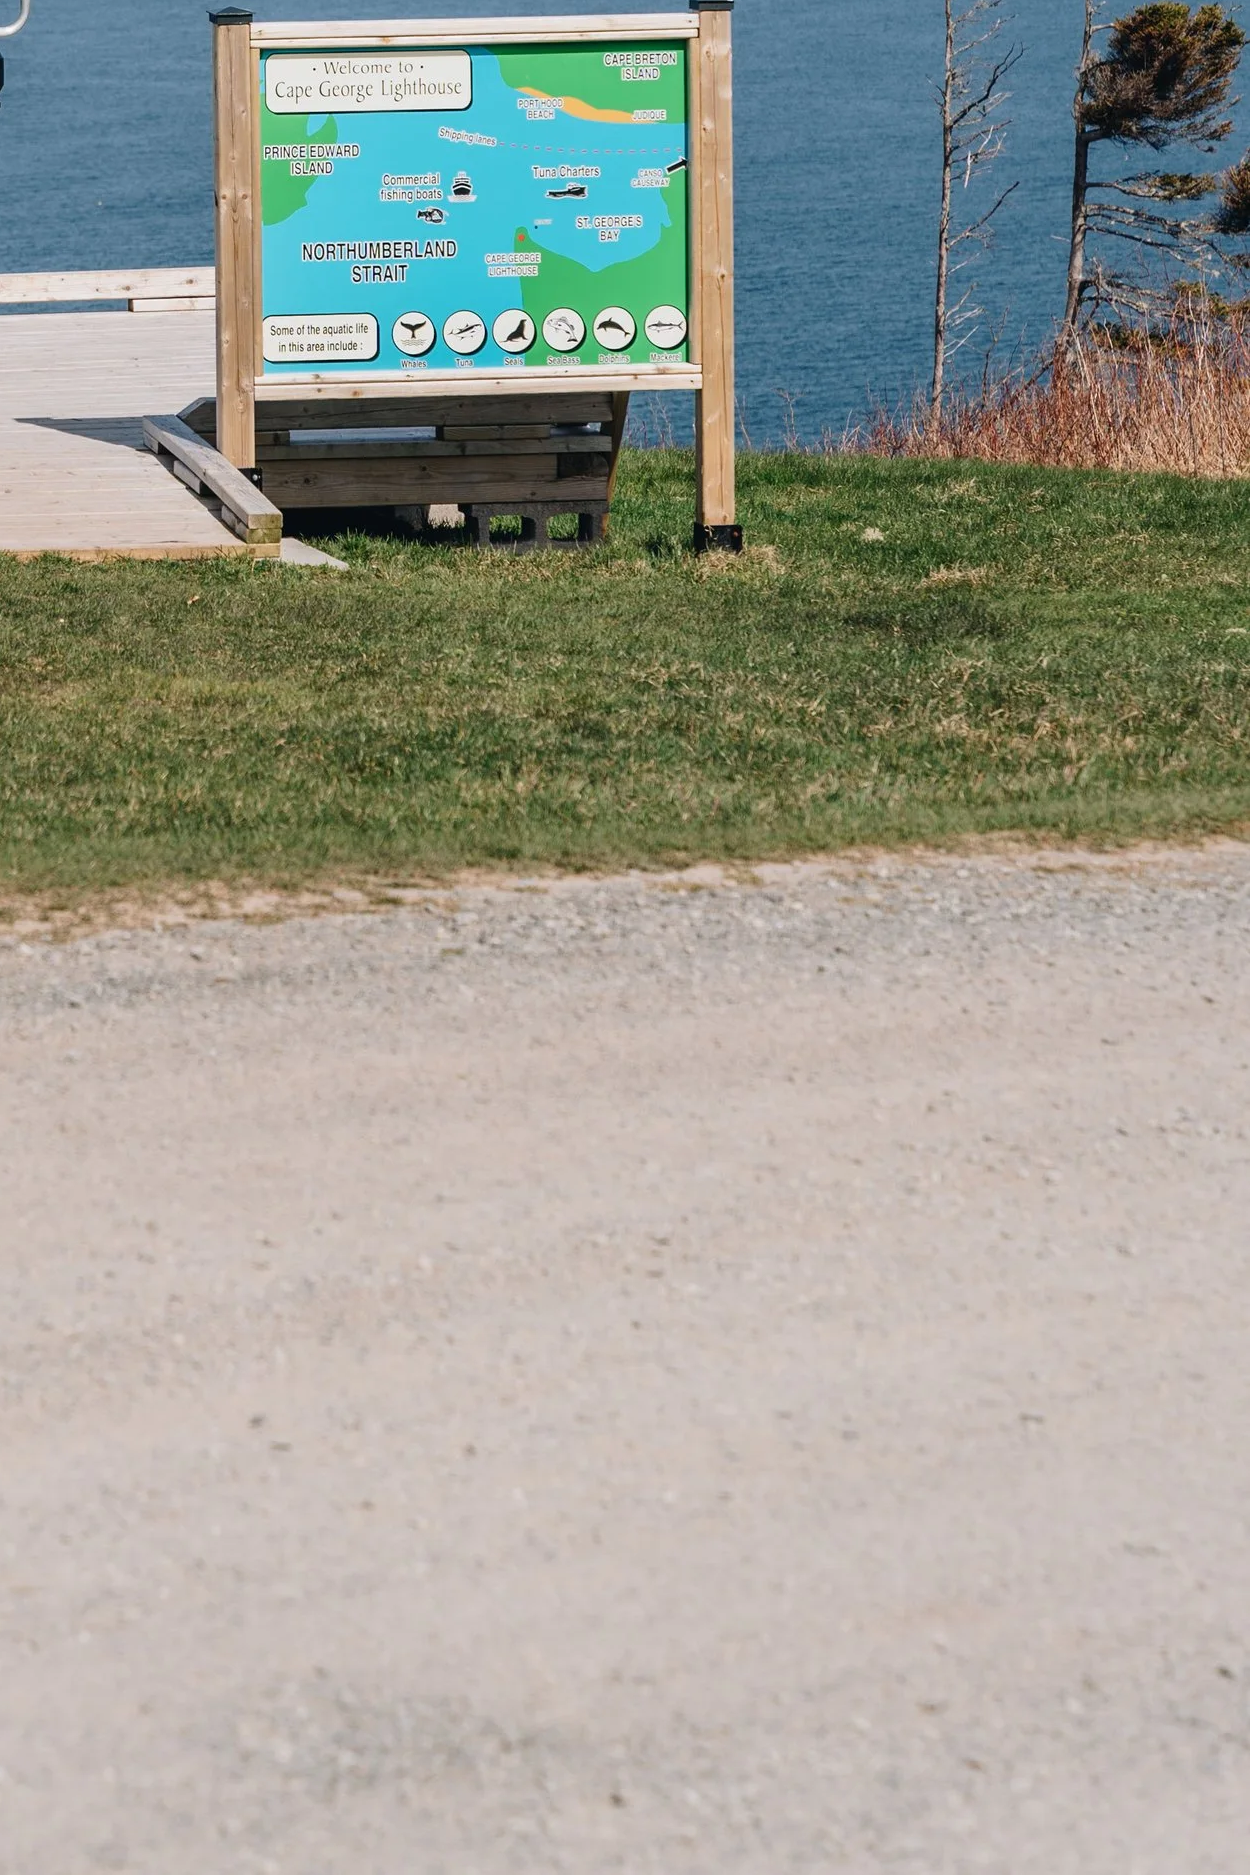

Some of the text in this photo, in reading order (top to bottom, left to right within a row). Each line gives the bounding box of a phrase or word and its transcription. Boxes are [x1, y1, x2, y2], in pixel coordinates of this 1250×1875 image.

[604, 53, 676, 65] CAPE BRETON
[323, 60, 413, 75] Welcome to
[622, 68, 659, 79] ISLAND
[275, 78, 462, 104] Cape George Lighthouse
[518, 99, 563, 108] PORT HOOD
[527, 110, 554, 119] BEACH
[633, 111, 665, 119] JUDIQUE
[439, 127, 496, 145] Shipping lanes
[264, 145, 359, 158] PRINCE EDWARD
[291, 162, 333, 175] ISLAND
[533, 166, 600, 178] Tuna Charters
[383, 174, 440, 185] Commercial
[632, 179, 669, 187] CAUSEWAY
[381, 188, 442, 202] fishing boats
[577, 218, 592, 228] ST.
[600, 231, 619, 241] BAY
[302, 241, 457, 260] NORTHUMBERLAND
[486, 254, 540, 263] CAPE GEORGE
[352, 265, 407, 283] STRAIT
[489, 267, 538, 276] LIGHTHOUSE
[270, 323, 368, 337] Some of the aquatic life
[278, 342, 286, 353] in
[288, 341, 304, 352] this
[307, 343, 324, 352] area
[327, 340, 358, 351] include
[504, 357, 524, 365] Seals
[548, 356, 580, 364] Sea Bass
[599, 354, 630, 364] Dolphins
[650, 353, 682, 361] Mackerel
[401, 360, 427, 368] Whales
[456, 359, 473, 367] Tuna
